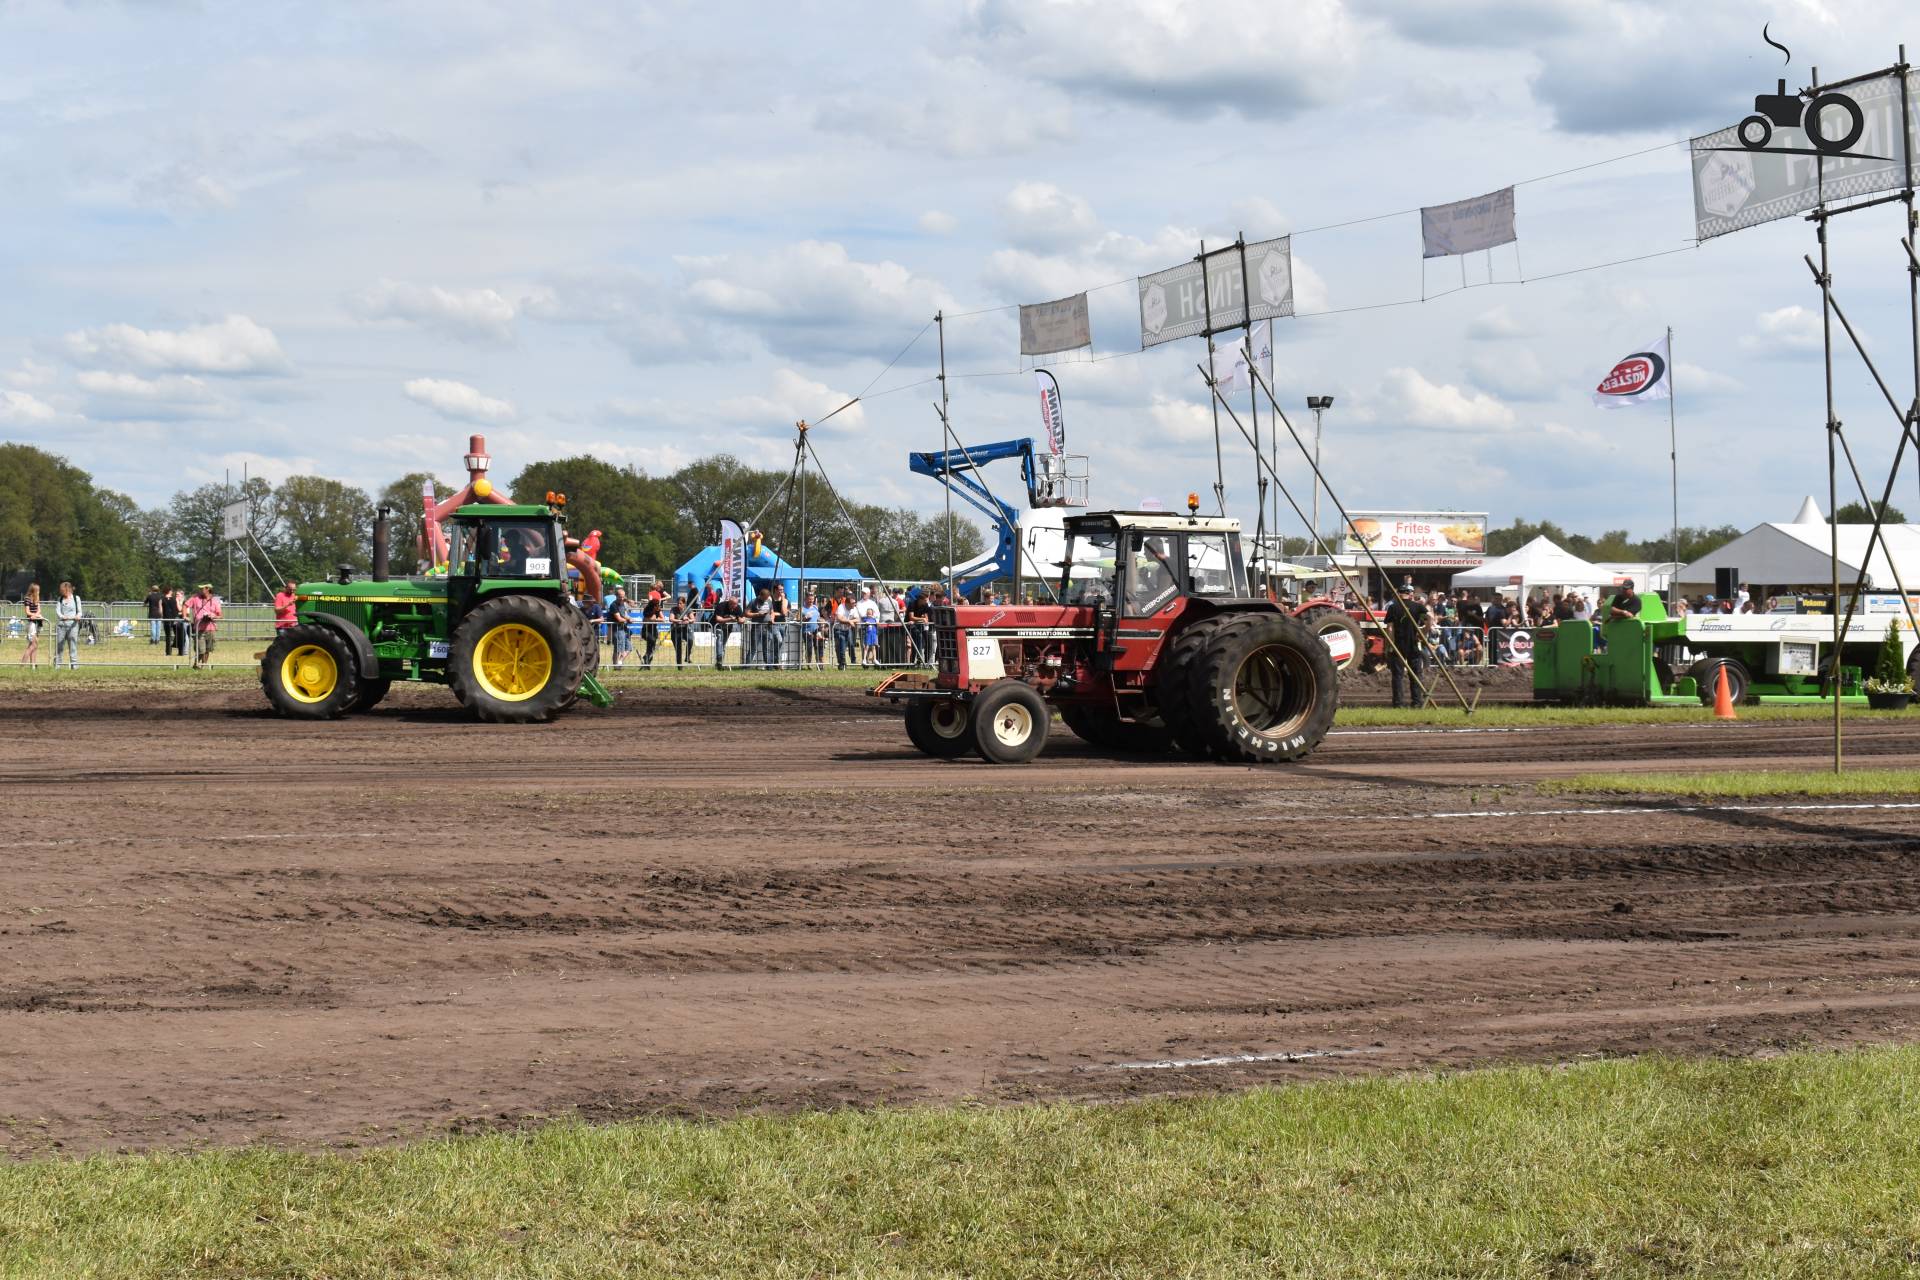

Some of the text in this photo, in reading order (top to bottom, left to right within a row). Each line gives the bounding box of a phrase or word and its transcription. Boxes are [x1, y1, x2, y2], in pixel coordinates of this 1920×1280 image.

[1396, 522, 1431, 534] Frites
[1391, 536, 1436, 547] Snacks
[529, 563, 546, 571] 903
[972, 646, 991, 656] 827
[1223, 688, 1306, 751] MICHELIN
